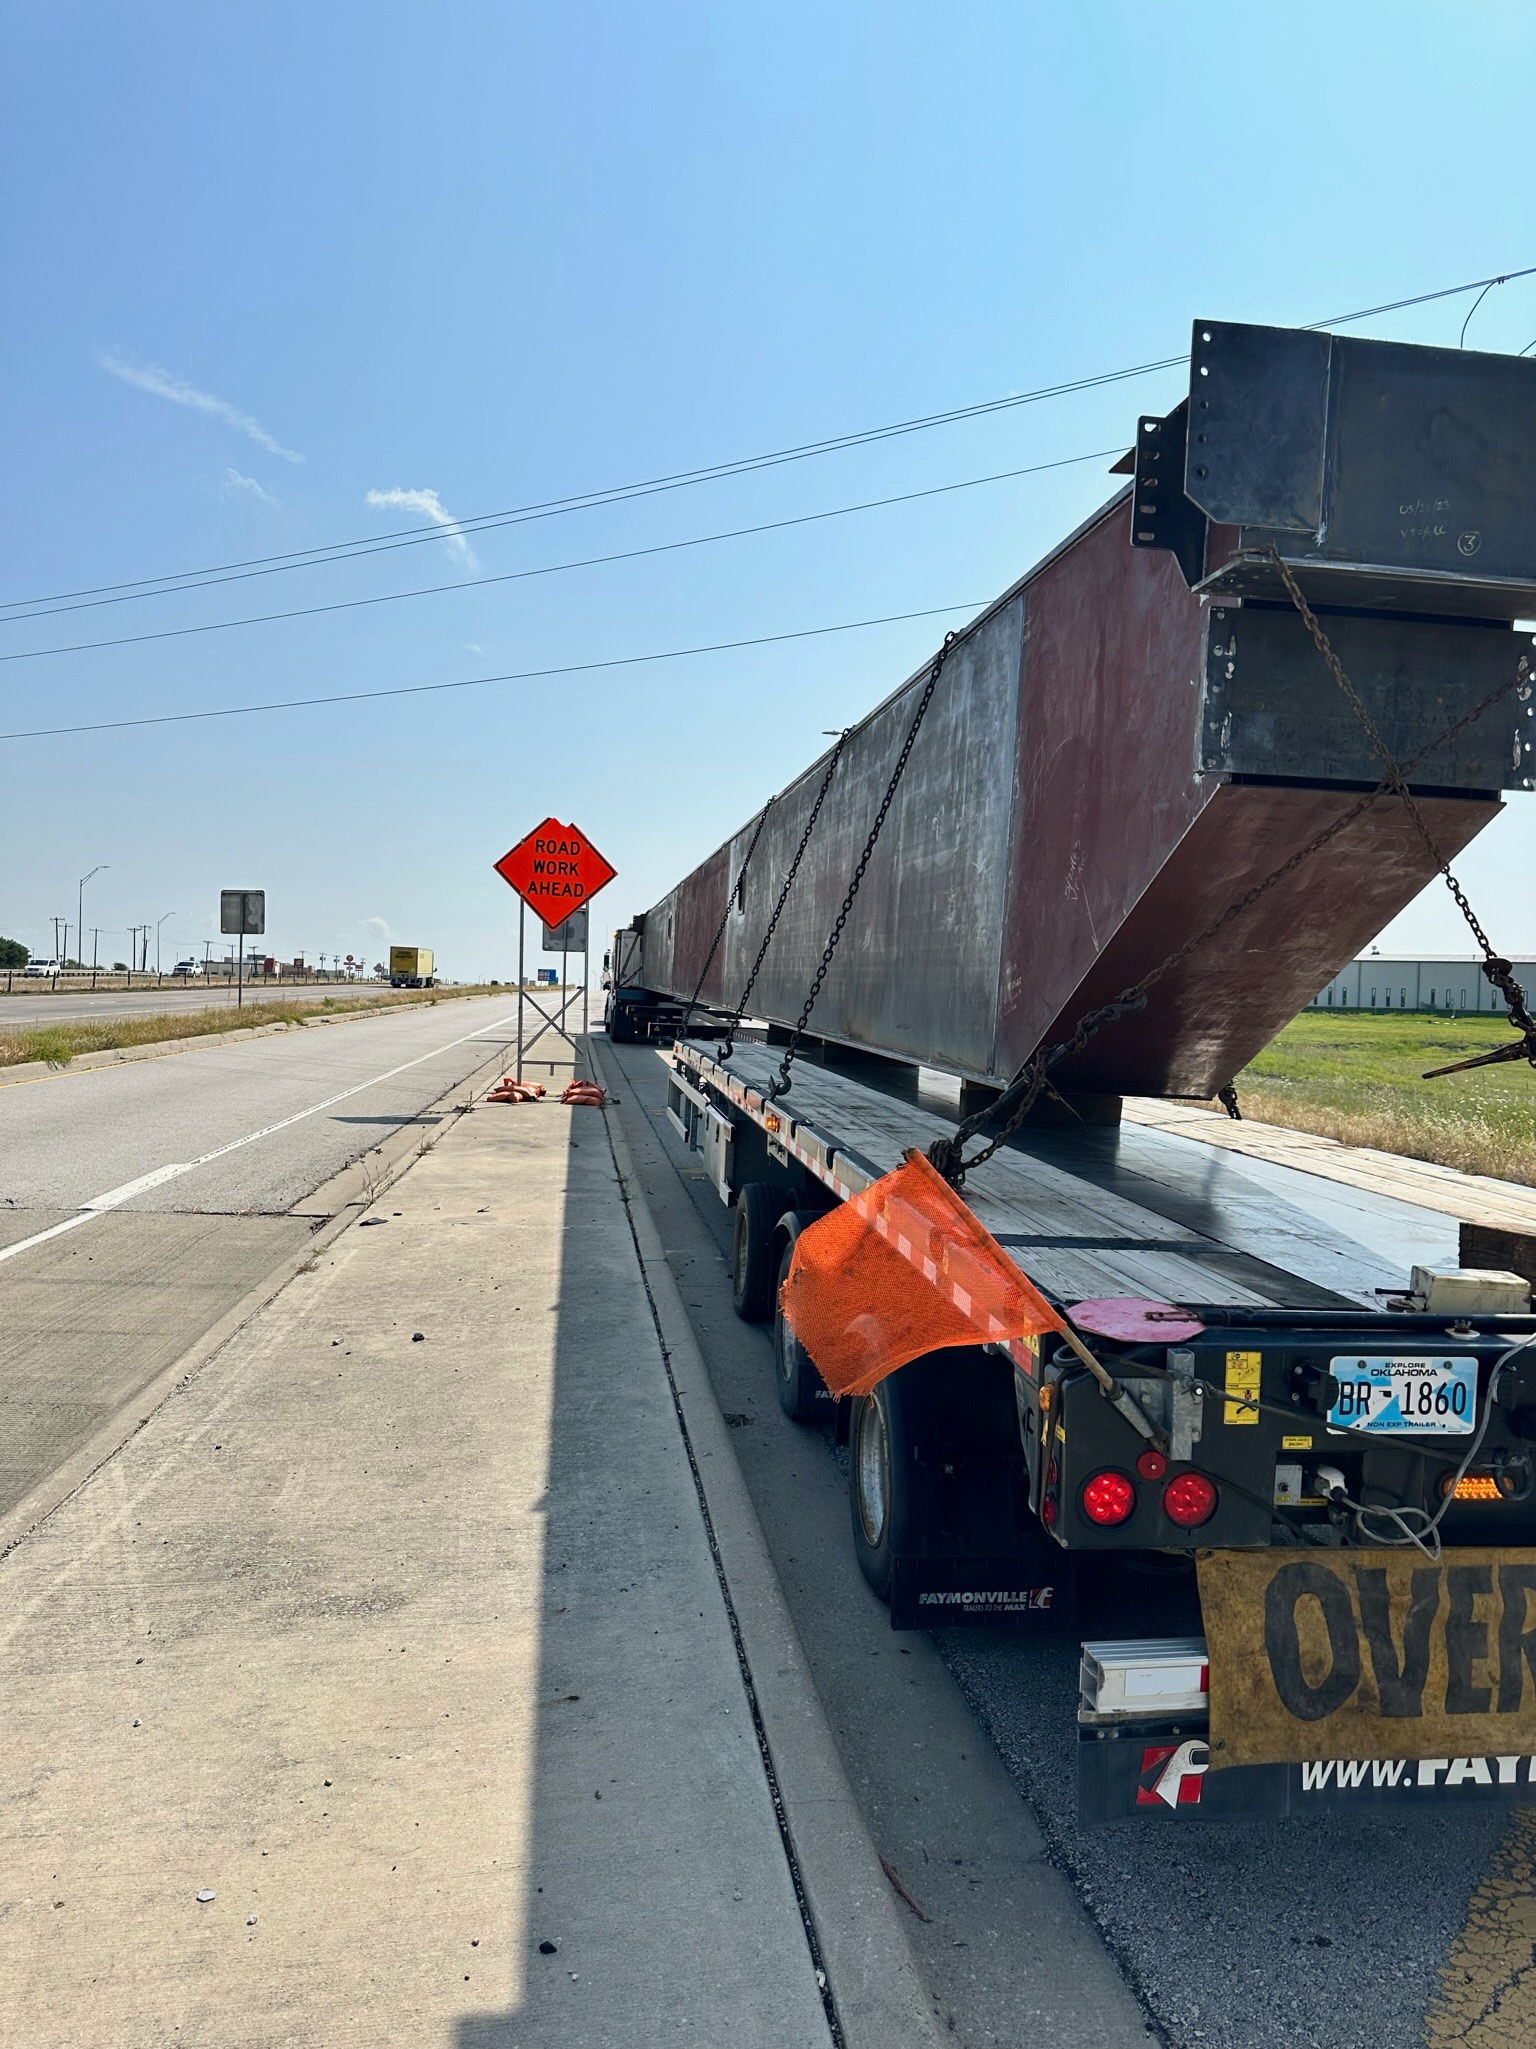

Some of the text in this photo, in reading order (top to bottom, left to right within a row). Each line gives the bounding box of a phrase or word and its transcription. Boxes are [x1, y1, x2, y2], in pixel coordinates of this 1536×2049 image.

[535, 840, 581, 855] ROAD
[533, 860, 579, 876] WORK
[527, 881, 584, 897] AHEAD
[1370, 1368, 1438, 1377] OKLAHOMA
[1339, 1381, 1466, 1415] BR 1860
[919, 1592, 1027, 1604] FAYMONVILLE
[1003, 1603, 1026, 1611] MAX
[1264, 1561, 1536, 1722] OVER
